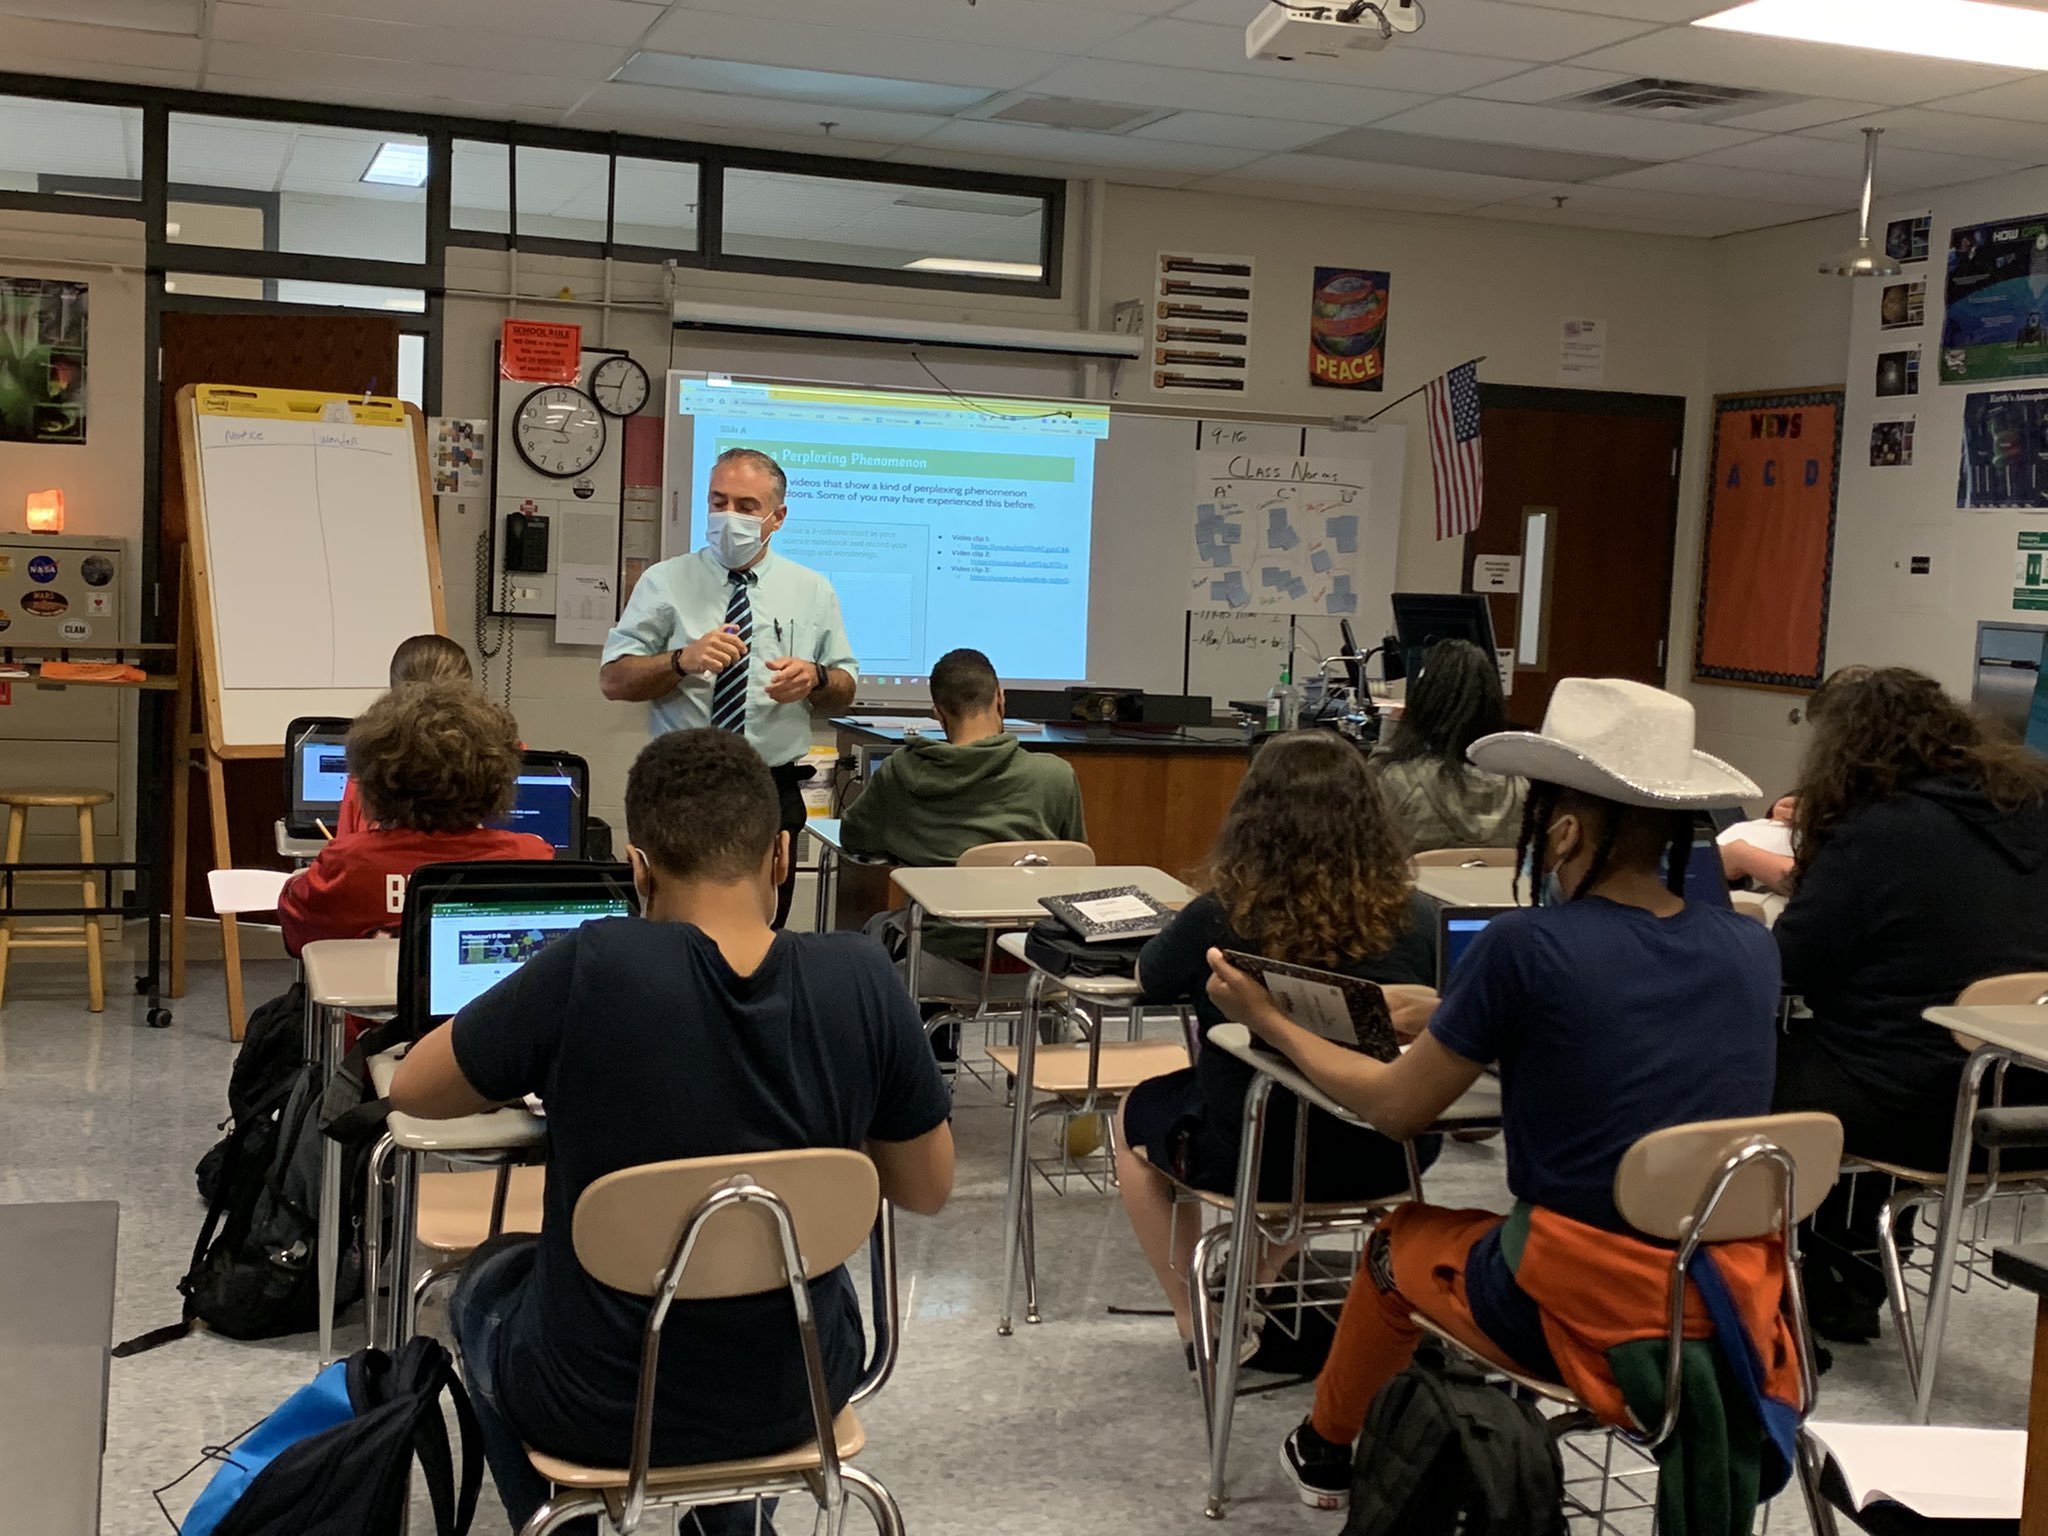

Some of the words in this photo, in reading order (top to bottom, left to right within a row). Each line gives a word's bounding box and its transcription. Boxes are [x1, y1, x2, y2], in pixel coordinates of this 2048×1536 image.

[1993, 228, 2019, 242] HOW
[1316, 354, 1376, 380] PEACE
[539, 396, 547, 406] 11
[557, 392, 567, 402] 12
[588, 411, 595, 420] 2
[522, 424, 530, 434] 9
[1751, 413, 1802, 439] NEWS
[592, 429, 599, 439] 3
[1211, 428, 1247, 444] 9-16
[528, 442, 535, 451] 8
[586, 445, 593, 455] 4
[540, 455, 547, 465] 7
[575, 457, 582, 467] 5
[782, 448, 847, 467] Perplexing
[852, 452, 927, 469] Phenomenon
[557, 462, 564, 472] 6
[1727, 464, 1740, 489] A
[1764, 460, 1776, 486] C
[1805, 459, 1819, 486] D
[789, 478, 821, 487] videos
[823, 479, 842, 488] that
[844, 480, 870, 490] show
[880, 481, 900, 491] kind
[902, 483, 912, 492] of
[914, 484, 963, 496] perplexing
[964, 487, 1028, 498] phenomenon
[816, 491, 845, 500] Some
[847, 491, 858, 501] of
[860, 494, 877, 503] you
[880, 495, 901, 504] may
[902, 494, 924, 504] have
[927, 497, 983, 507] experienced
[985, 499, 1002, 508] this
[1004, 500, 1037, 510] before.
[64, 625, 86, 634] CLAM
